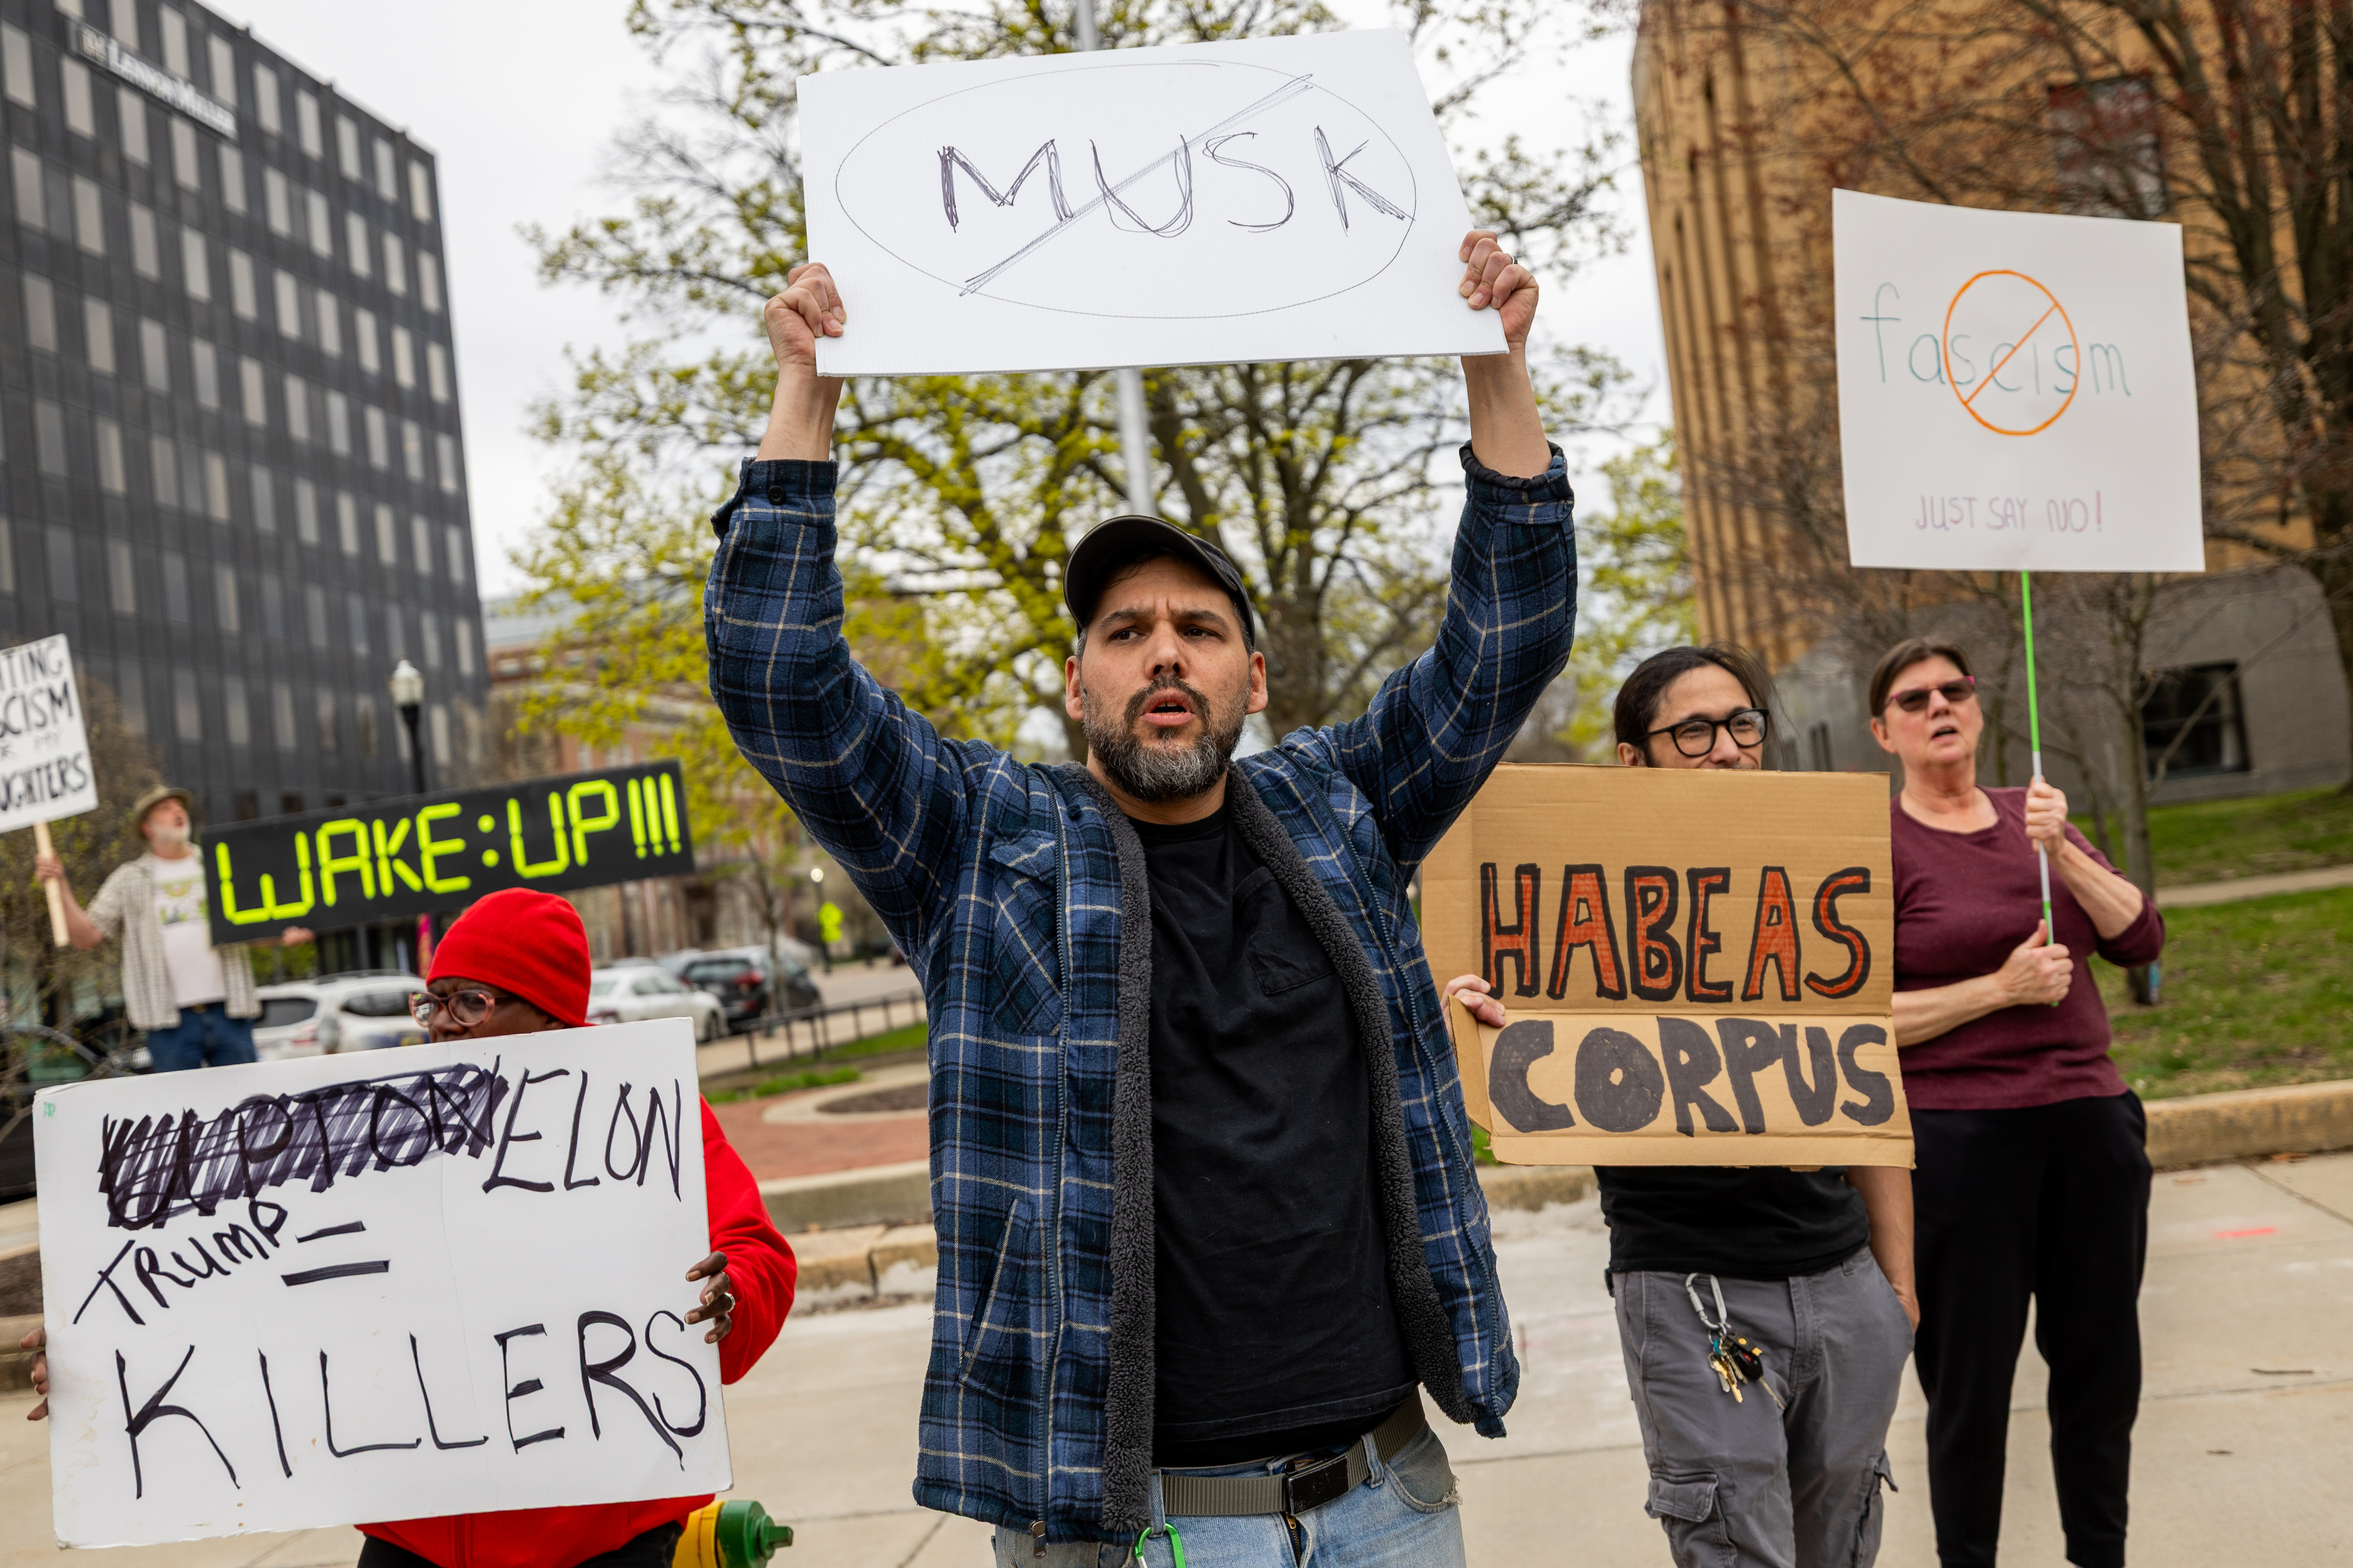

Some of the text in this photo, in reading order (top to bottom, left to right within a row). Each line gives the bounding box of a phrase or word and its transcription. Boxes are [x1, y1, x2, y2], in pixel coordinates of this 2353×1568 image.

[937, 125, 1415, 238] MUSK
[1860, 282, 2131, 397] fascism
[1916, 490, 2103, 533] JUST SAY NO!
[0, 638, 64, 691] TING
[0, 680, 74, 738] CISM
[1480, 862, 1872, 1003] HABEAS
[484, 1067, 682, 1203] ELON
[1488, 1015, 1895, 1138] CORPUS
[73, 1200, 288, 1326] TRUMP
[115, 1310, 707, 1500] KILLERS
